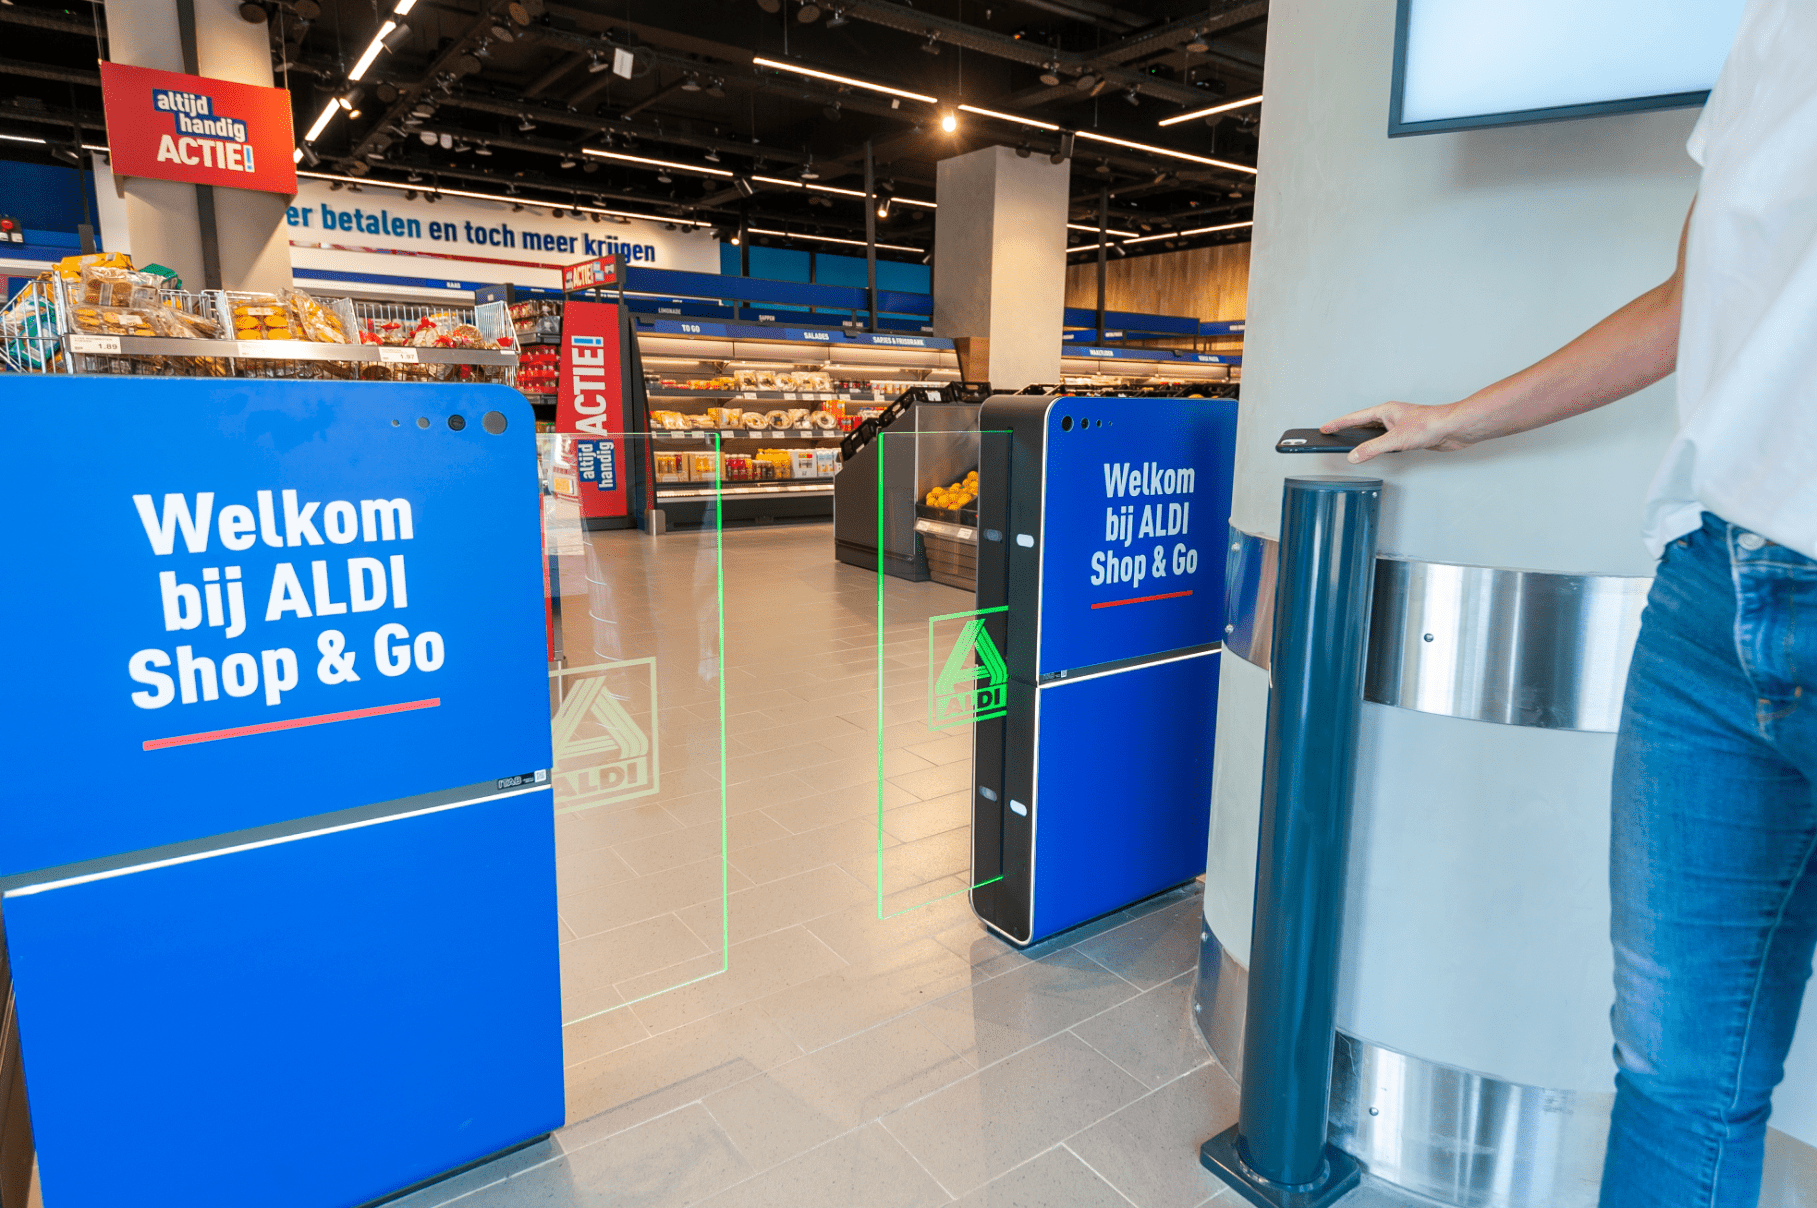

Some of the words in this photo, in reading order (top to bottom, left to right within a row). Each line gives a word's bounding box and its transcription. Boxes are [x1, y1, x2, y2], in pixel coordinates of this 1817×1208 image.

[156, 91, 209, 117] altijd
[178, 112, 246, 143] handig
[156, 134, 256, 173] ACTIE!
[321, 203, 422, 239] betalen
[429, 221, 458, 242] en
[464, 220, 516, 248] toch
[522, 231, 578, 254] meer
[681, 324, 692, 333] TO
[692, 325, 701, 333] GO
[571, 335, 608, 437] ACTIE!
[578, 443, 596, 480] altijd
[597, 441, 615, 489] handig
[1103, 461, 1195, 498] Welkom
[132, 489, 414, 556] Welkom
[1105, 505, 1134, 548] bij
[1138, 501, 1190, 539] ALDI
[1090, 549, 1147, 588] Shop
[1151, 544, 1167, 578] &
[1172, 542, 1198, 576] Go
[159, 565, 247, 639] bij
[265, 554, 408, 622] ALDI
[128, 644, 299, 709] Shop
[316, 629, 361, 685] &
[373, 622, 445, 677] Go
[552, 761, 638, 798] ALDI
